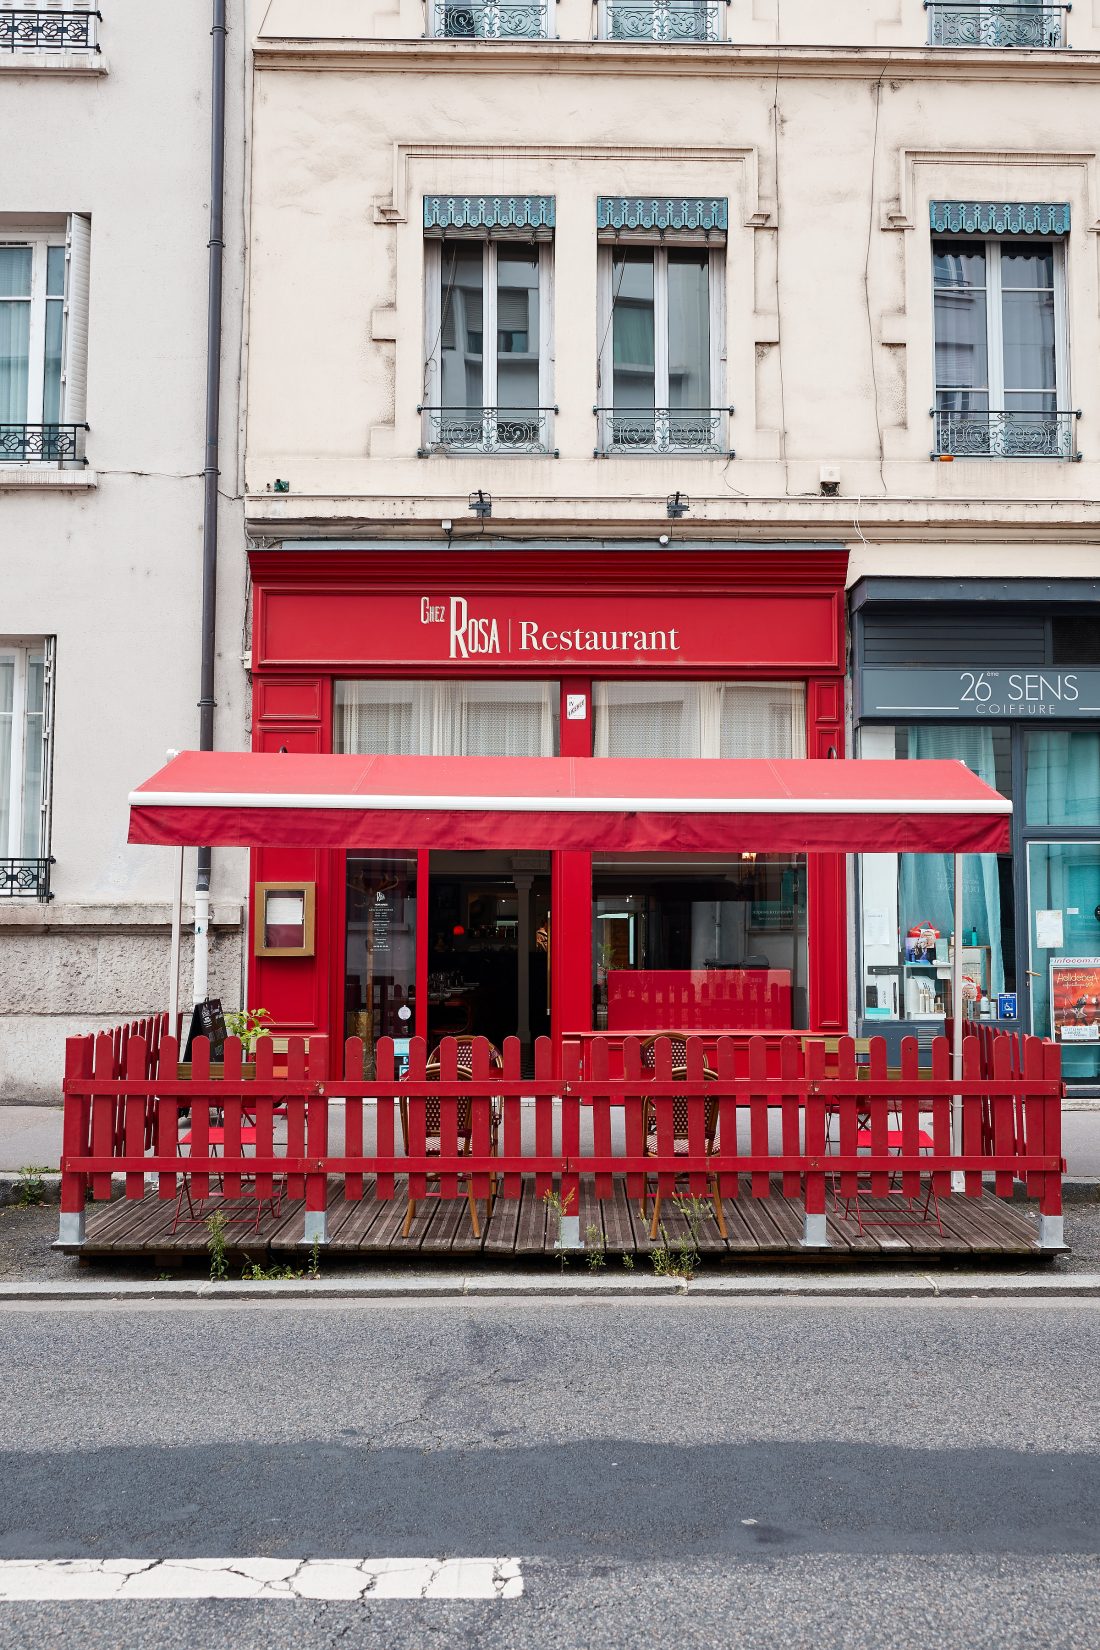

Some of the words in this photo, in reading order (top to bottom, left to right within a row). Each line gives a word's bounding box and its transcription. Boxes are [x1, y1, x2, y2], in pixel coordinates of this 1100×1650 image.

[449, 596, 500, 658] ROSA
[518, 620, 681, 651] Restaurant
[1008, 674, 1079, 701] SENS
[975, 703, 1056, 715] COIFFURE
